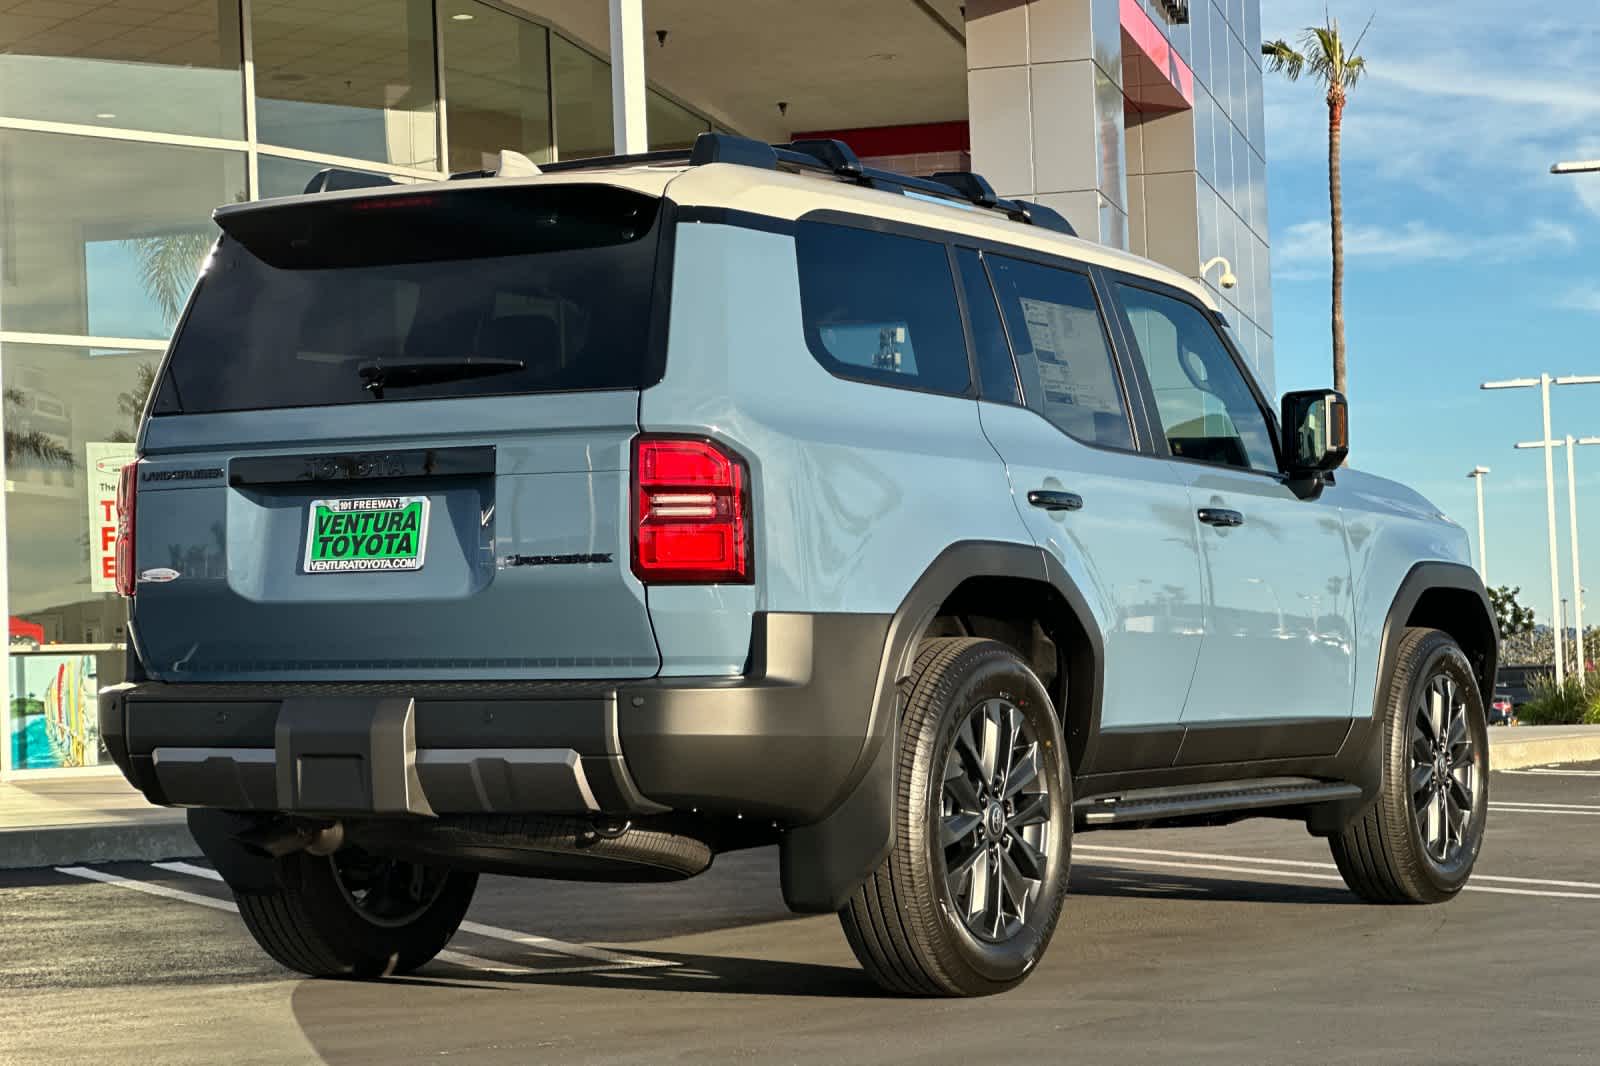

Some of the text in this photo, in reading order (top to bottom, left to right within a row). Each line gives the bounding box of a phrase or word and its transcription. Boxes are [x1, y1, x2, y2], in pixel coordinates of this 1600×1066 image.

[339, 499, 399, 510] 101 FREEWAY
[318, 510, 417, 535] VENTURA
[318, 532, 412, 557] TOYOTA
[310, 558, 416, 571] VENTURATOYOTA.COM
